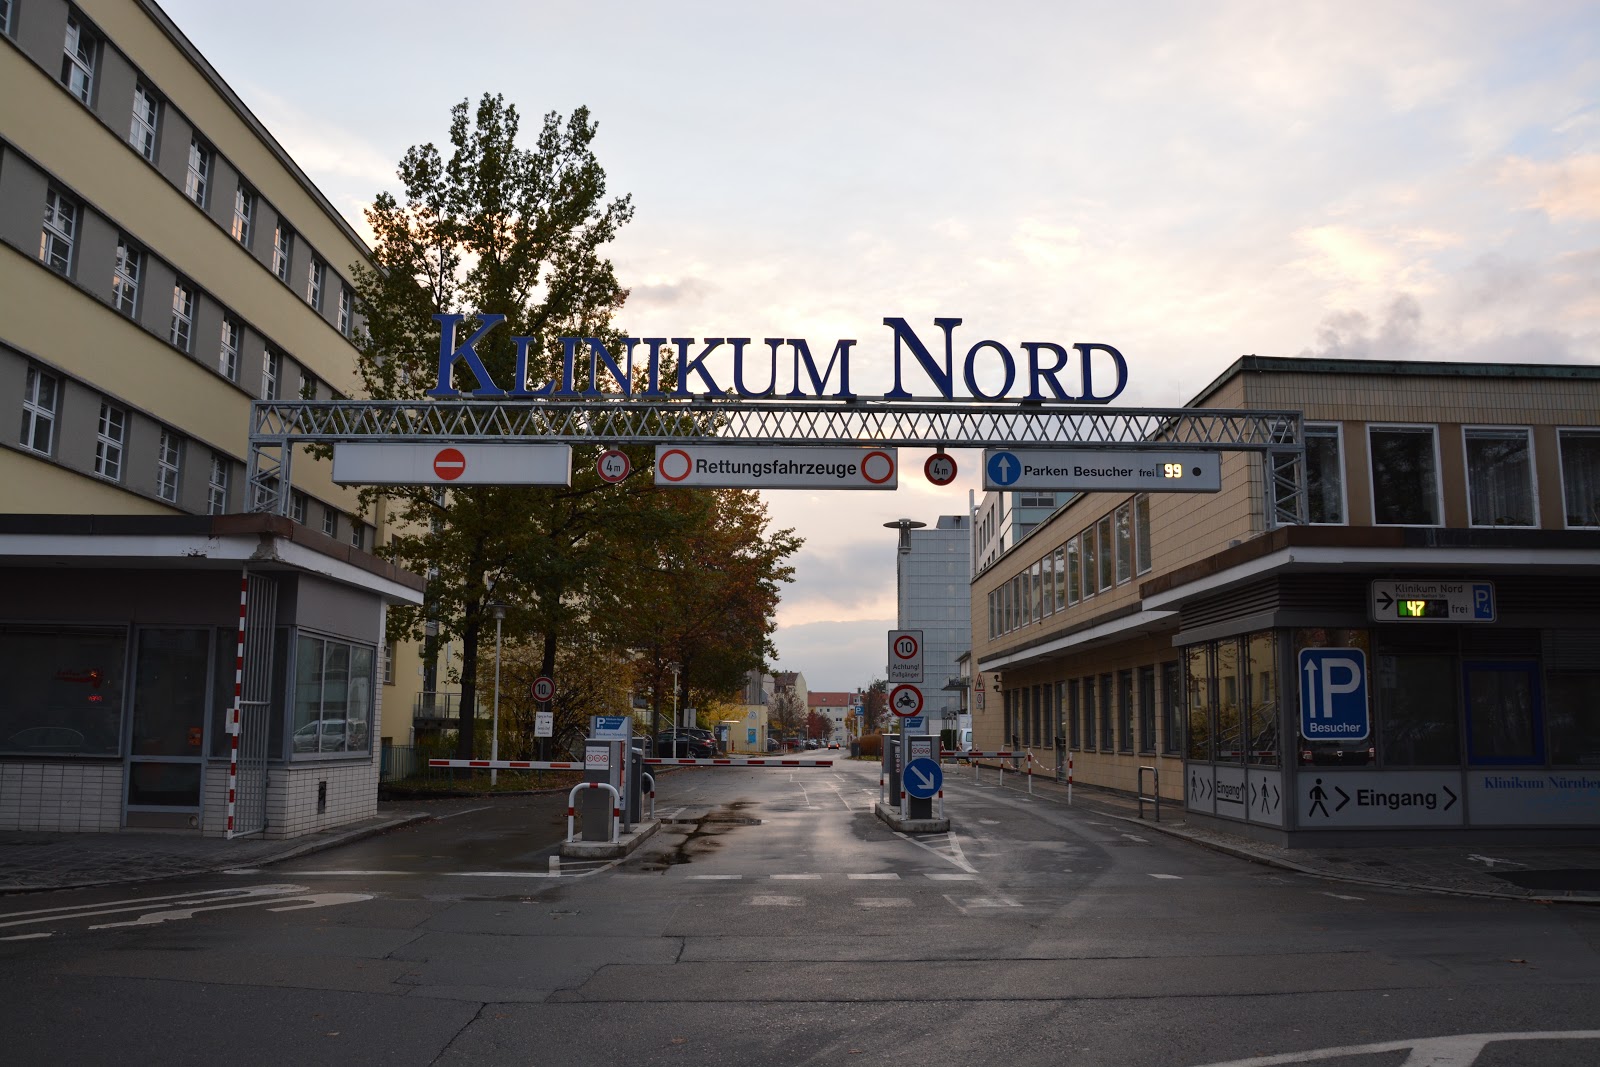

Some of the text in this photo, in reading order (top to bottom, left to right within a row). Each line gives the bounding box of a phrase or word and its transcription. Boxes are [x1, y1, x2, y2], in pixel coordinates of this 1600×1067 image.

[426, 314, 1128, 401] KLINIKUM NORD
[696, 459, 857, 478] Rettungsfahrzeuge
[1024, 463, 1183, 478] Parken Besucher frei 99
[1395, 584, 1463, 593] Klinikum Nord
[1406, 600, 1426, 617] 47
[1451, 604, 1468, 614] frei
[899, 642, 913, 653] 10
[892, 663, 920, 671] Achtung!
[892, 671, 920, 679] Fußgänger
[537, 683, 547, 695] 10
[1321, 658, 1362, 718] P
[1310, 722, 1361, 733] Besucher
[1216, 780, 1240, 799] Eingang
[1484, 776, 1544, 789] Klinikum
[1357, 789, 1437, 811] Eingang
